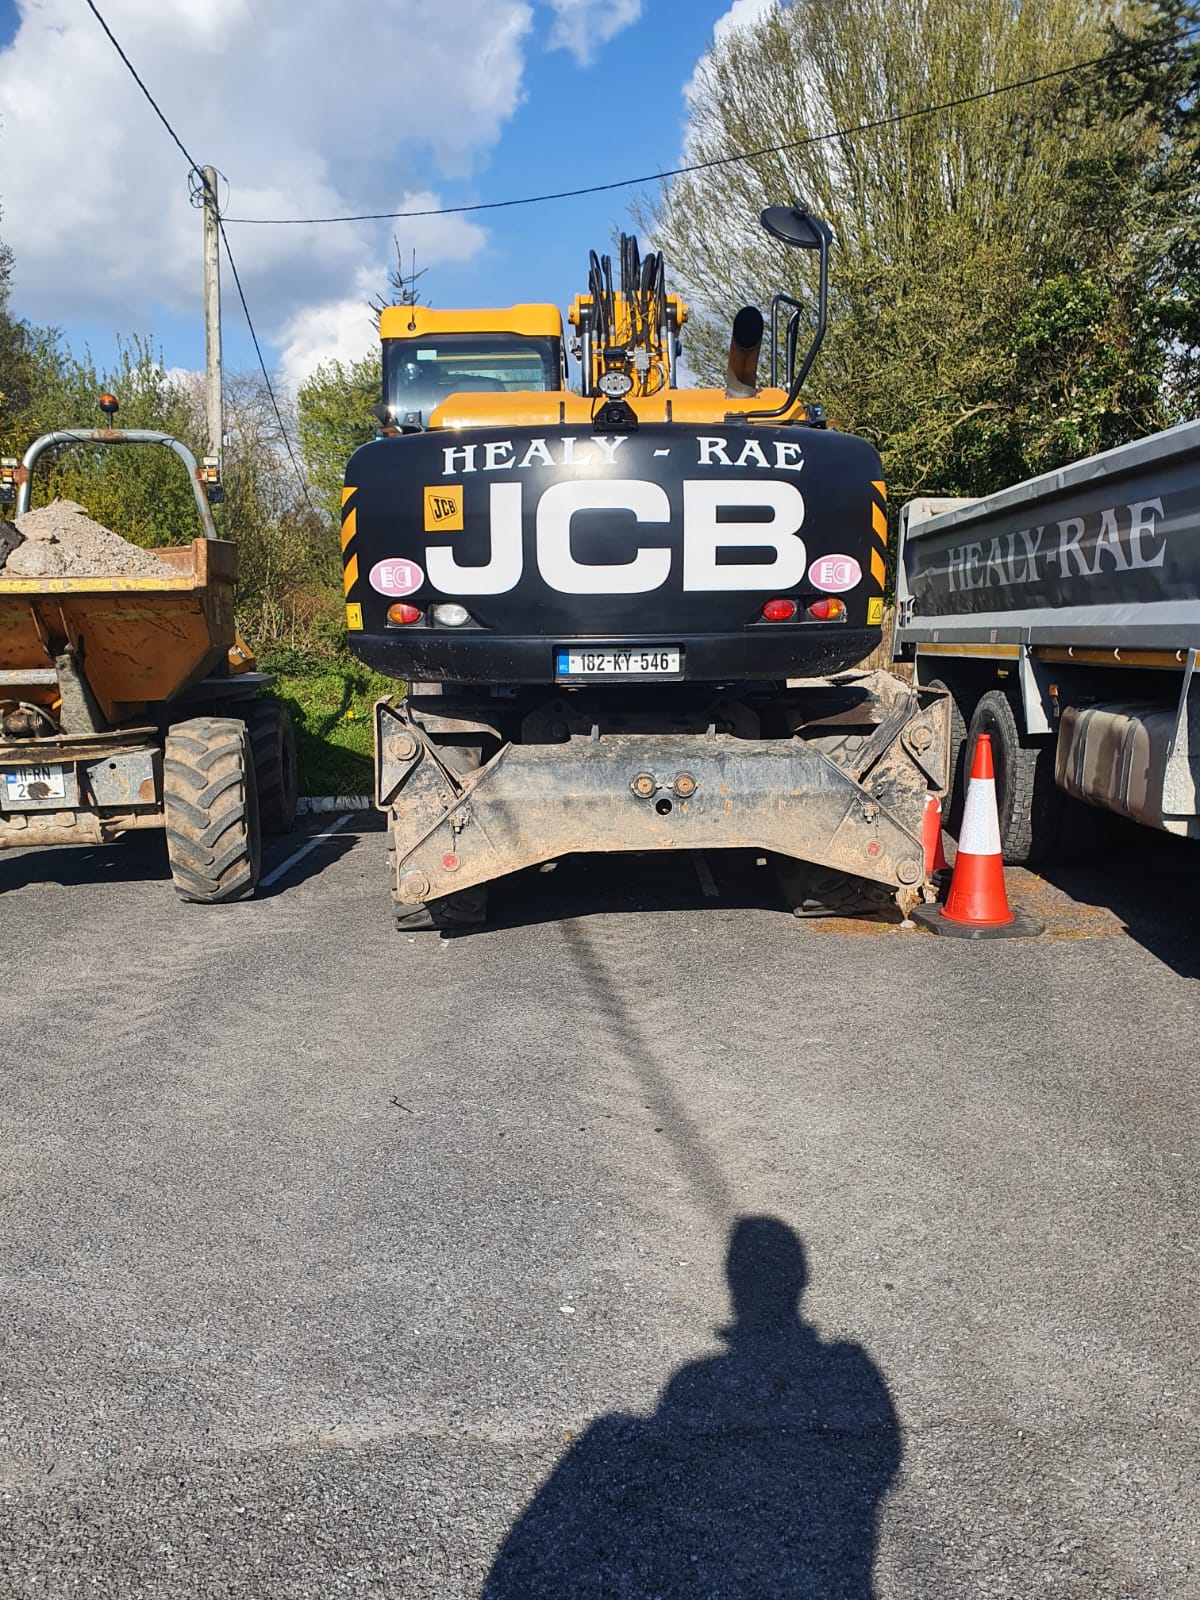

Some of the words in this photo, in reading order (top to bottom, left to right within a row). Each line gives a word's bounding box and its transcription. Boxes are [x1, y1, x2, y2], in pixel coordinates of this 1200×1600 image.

[441, 436, 628, 475] HEALY
[696, 436, 804, 471] RAE
[433, 498, 456, 520] JCB
[425, 479, 807, 595] JCB
[948, 497, 1166, 593] HEALY-RAE
[580, 653, 669, 672] 182-KY-546
